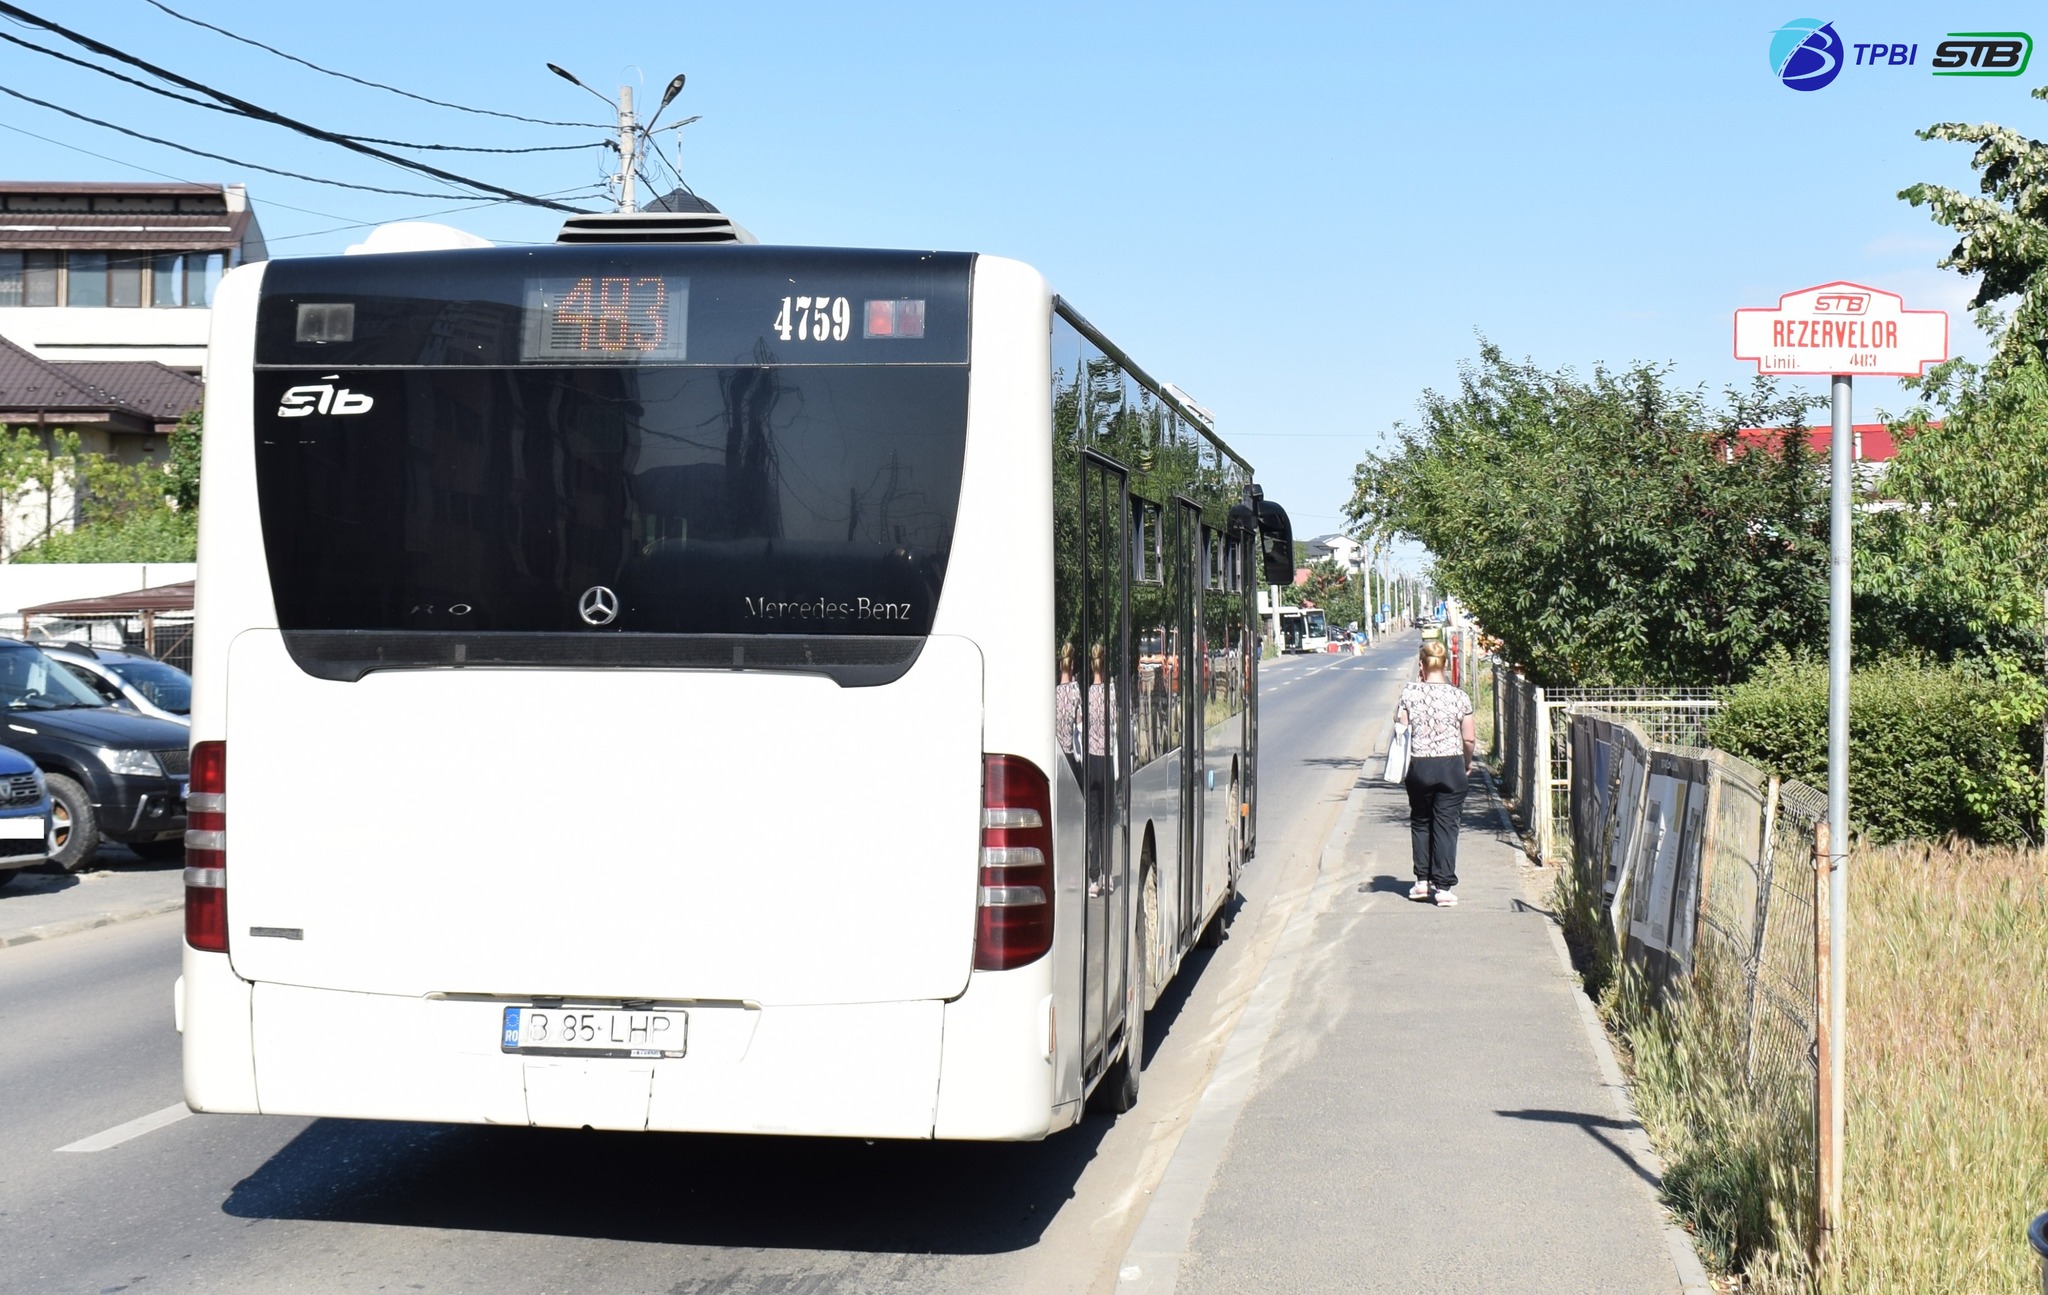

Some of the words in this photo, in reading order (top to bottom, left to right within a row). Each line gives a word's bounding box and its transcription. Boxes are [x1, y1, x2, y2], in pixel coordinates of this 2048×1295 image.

[557, 277, 666, 352] 483
[1814, 294, 1865, 312] STB
[773, 296, 851, 342] 4759
[1773, 319, 1898, 349] REZERVELOR
[744, 596, 911, 619] Mercedes-Benz
[505, 1029, 519, 1042] RO
[530, 1013, 548, 1041] B
[563, 1014, 595, 1042] 85
[610, 1015, 671, 1044] LHP
